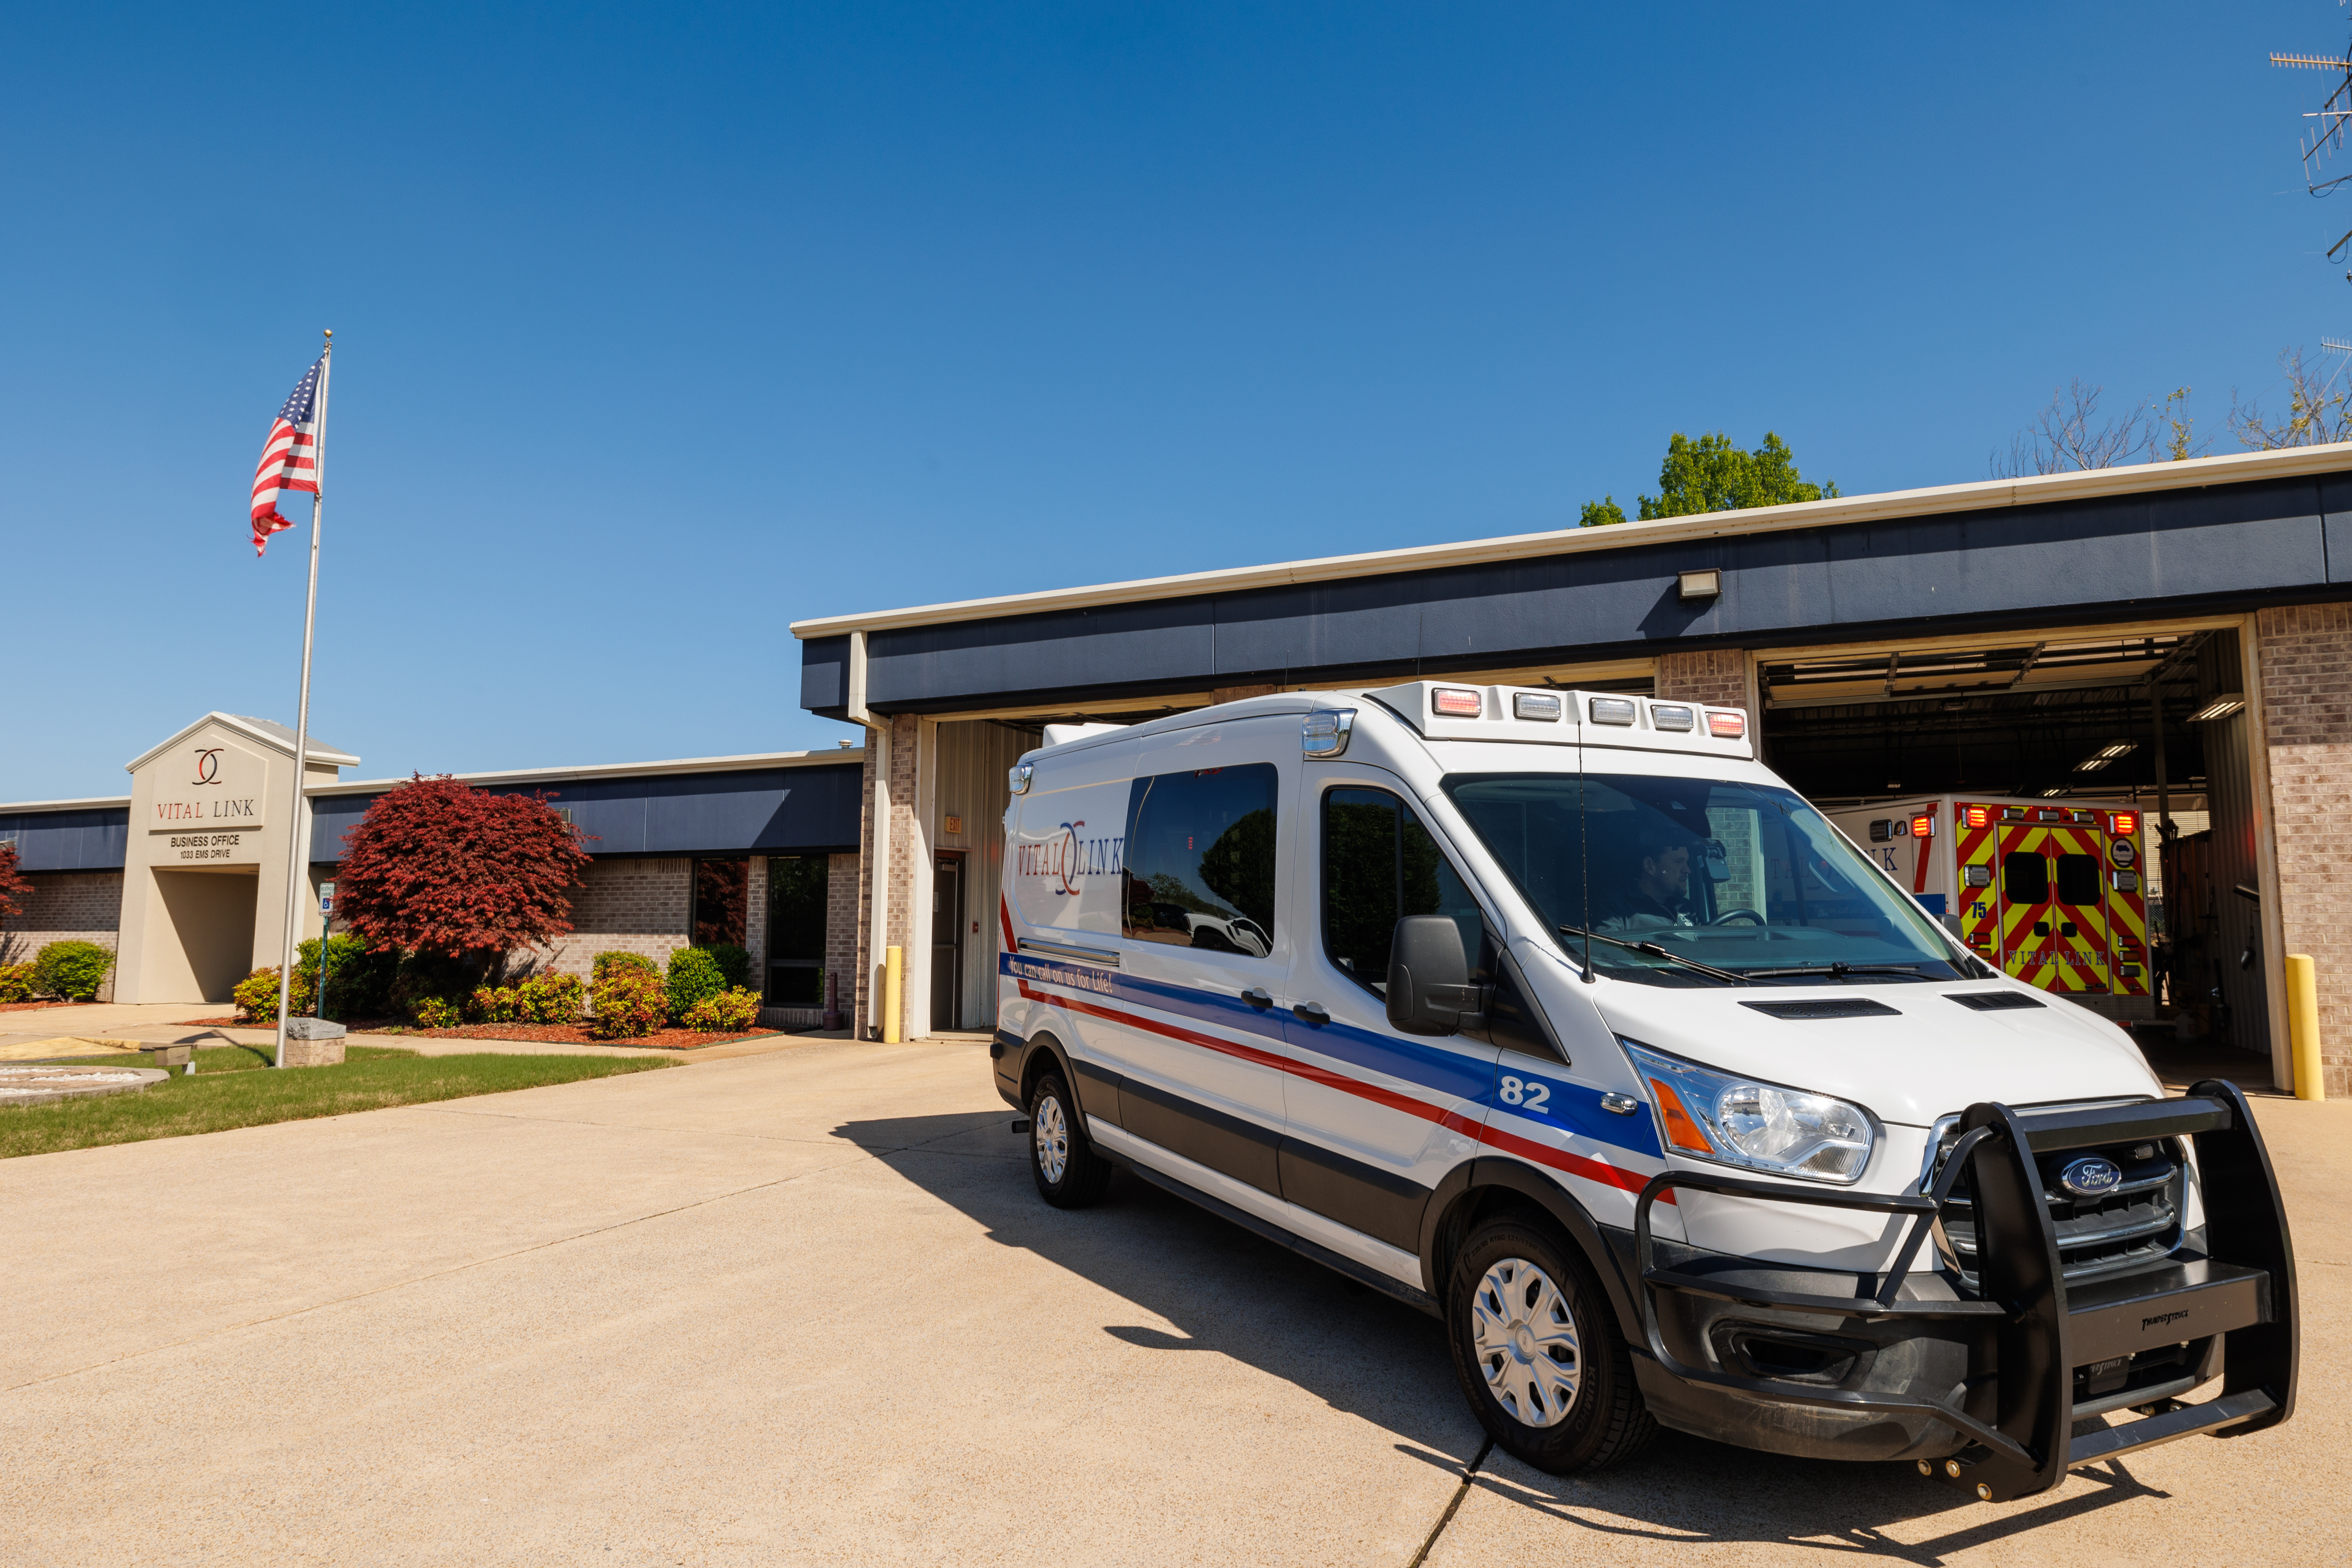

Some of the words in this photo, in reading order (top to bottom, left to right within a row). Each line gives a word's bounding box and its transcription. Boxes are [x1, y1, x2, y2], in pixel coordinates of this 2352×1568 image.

[157, 802, 203, 819] VITAL
[213, 799, 254, 817] LINK
[950, 817, 960, 832] EXIT
[171, 836, 208, 847] BUSINESS
[211, 835, 239, 846] OFFICE
[180, 851, 193, 859] 1033
[196, 850, 209, 859] EMS
[211, 849, 230, 858] DRIVE
[1019, 843, 1060, 876] VITAL
[1077, 837, 1124, 875] LINK
[1970, 901, 1987, 919] 75
[2008, 951, 2058, 965] VITAL
[2064, 951, 2105, 965] LINK
[1009, 956, 1023, 975] You
[1024, 963, 1036, 978] can
[1038, 963, 1051, 982] call
[1052, 970, 1063, 985] on
[1065, 971, 1075, 987] us
[1077, 968, 1089, 989] for
[1092, 970, 1113, 994] Life!
[1500, 1076, 1550, 1114] 82
[2081, 1165, 2113, 1187] Ford
[1471, 1239, 1489, 1257] 235/65
[1489, 1234, 1506, 1243] R16C
[1508, 1235, 1538, 1251] 121/119R
[1575, 1365, 1596, 1432] KUMHO
